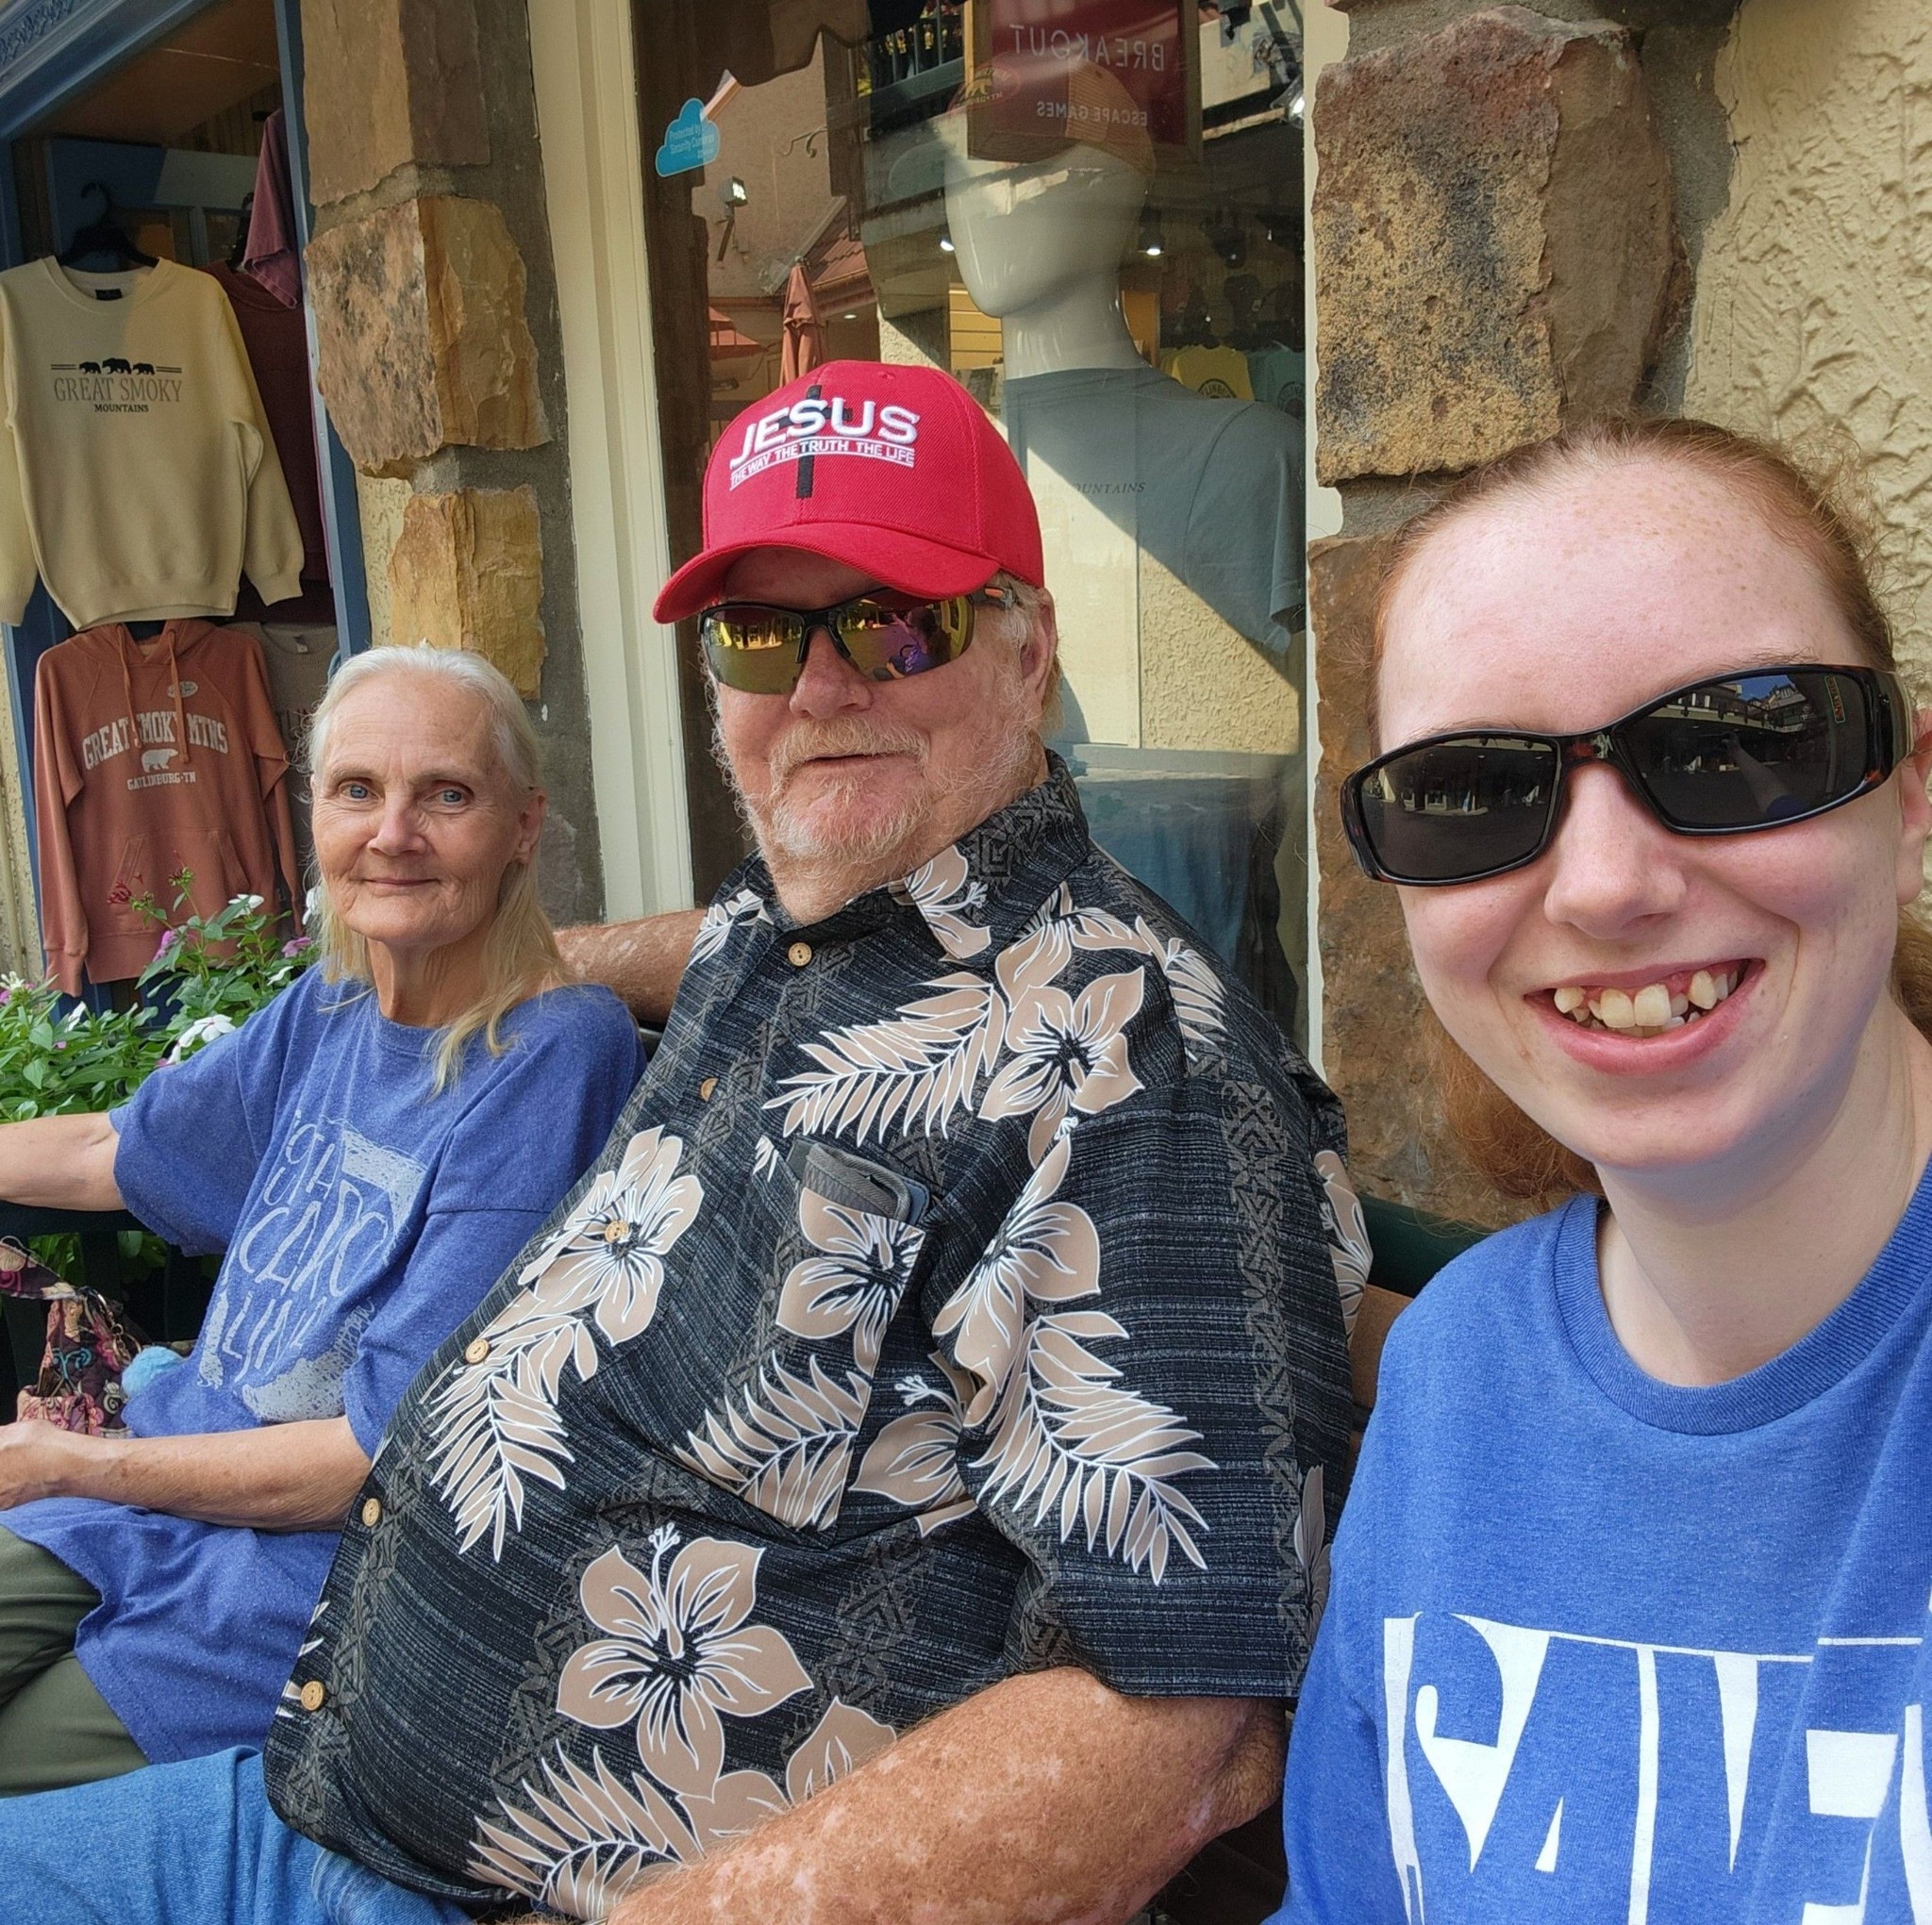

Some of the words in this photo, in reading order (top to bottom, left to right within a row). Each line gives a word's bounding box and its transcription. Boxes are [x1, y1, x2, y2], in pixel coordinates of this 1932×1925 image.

[54, 376, 114, 402] GREAT
[120, 377, 183, 402] SMOKY
[94, 403, 150, 413] MOUNTAINS
[729, 396, 921, 470] JESUS
[747, 452, 772, 476] WAY
[774, 443, 799, 462] THE
[799, 439, 850, 455] TRUTH
[856, 440, 884, 457] THE
[885, 446, 915, 465] LIFE
[1073, 481, 1147, 495] OUNTAINS
[82, 716, 131, 771] GREAT
[186, 712, 228, 755] MTNS
